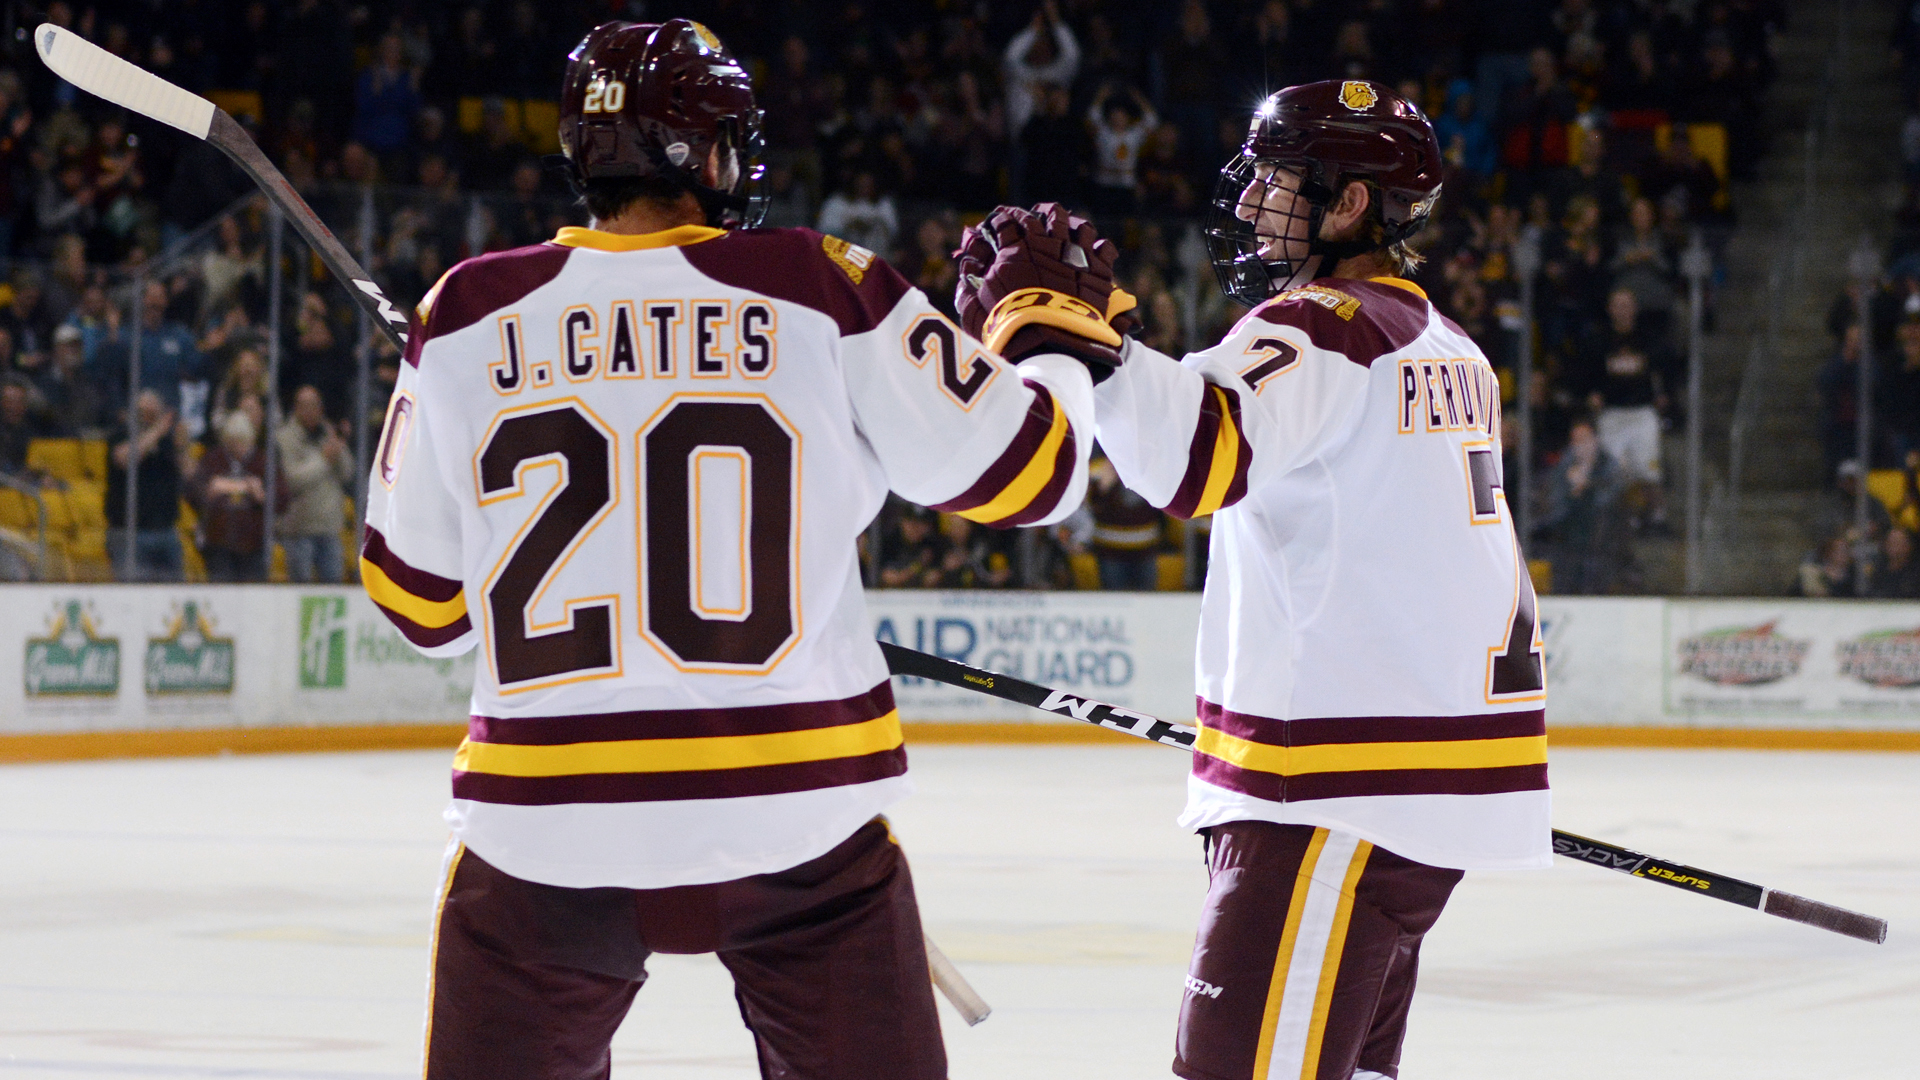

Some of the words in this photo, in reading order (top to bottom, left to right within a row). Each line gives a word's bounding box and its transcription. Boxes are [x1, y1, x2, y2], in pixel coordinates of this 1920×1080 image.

[583, 81, 626, 114] 20
[1236, 335, 1304, 397] 7
[472, 391, 803, 696] 20
[1462, 438, 1547, 704] 7
[874, 616, 981, 688] AIR
[984, 614, 1130, 644] NATIONAL
[982, 649, 1134, 687] GUARD
[1648, 866, 1711, 890] SUPER
